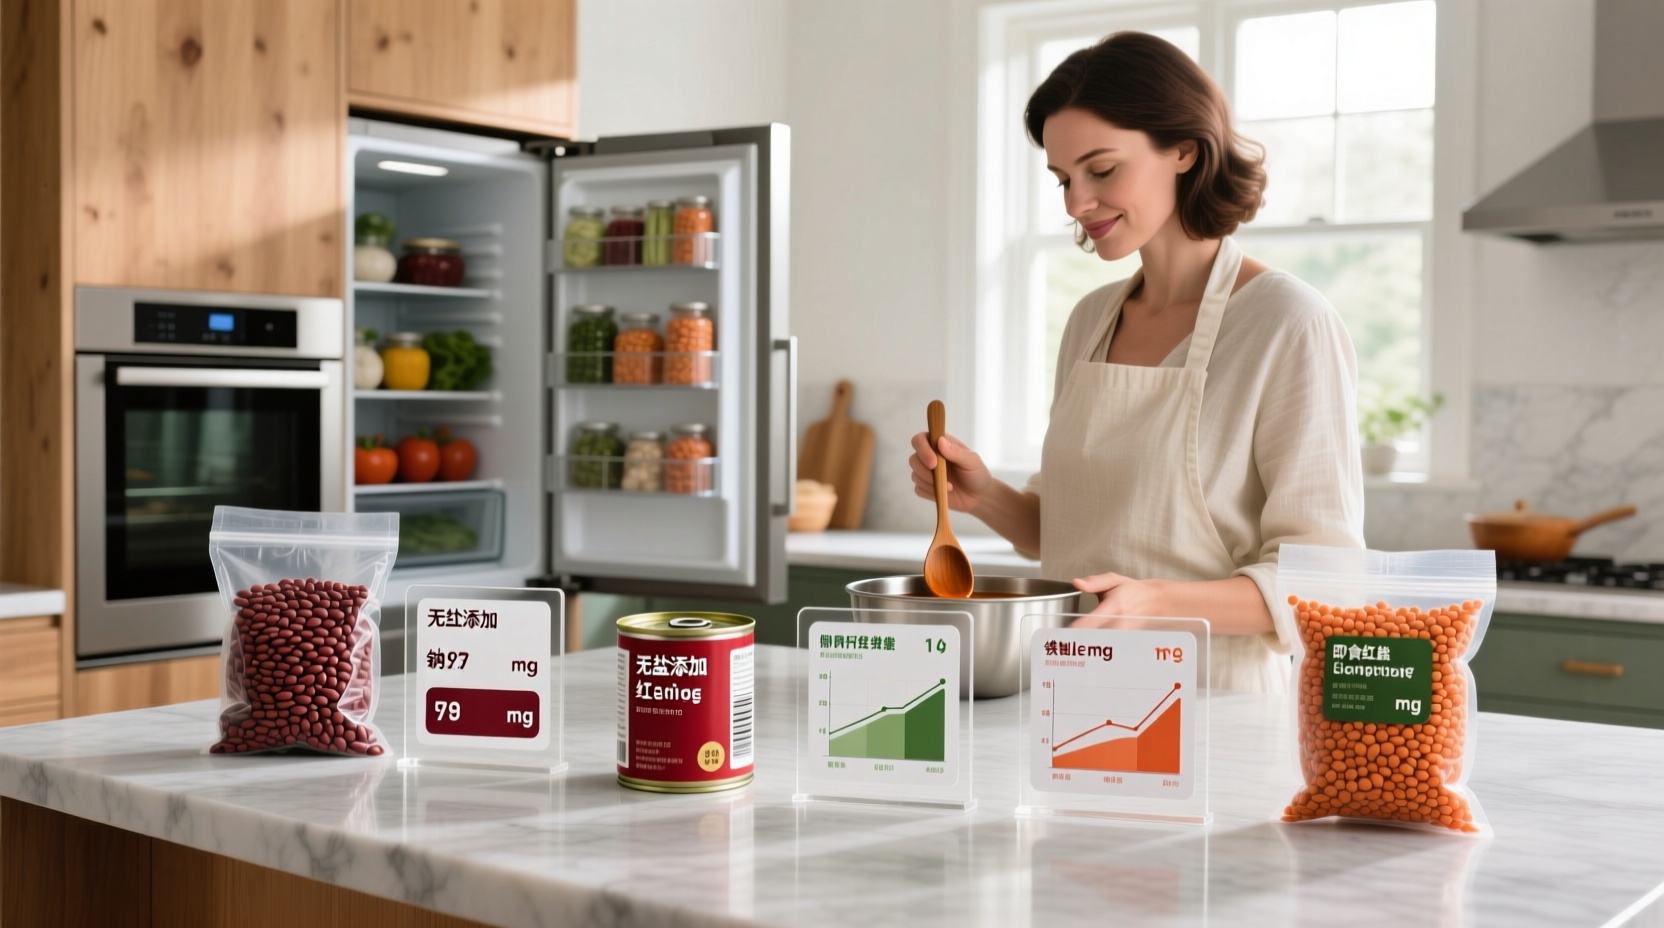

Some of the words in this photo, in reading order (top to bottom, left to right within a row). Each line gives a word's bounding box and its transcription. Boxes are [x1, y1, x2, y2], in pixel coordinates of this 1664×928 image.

[511, 660, 538, 678] mg
[635, 654, 708, 677] 无盐添加
[1395, 698, 1422, 716] mg
[507, 709, 534, 729] mg
